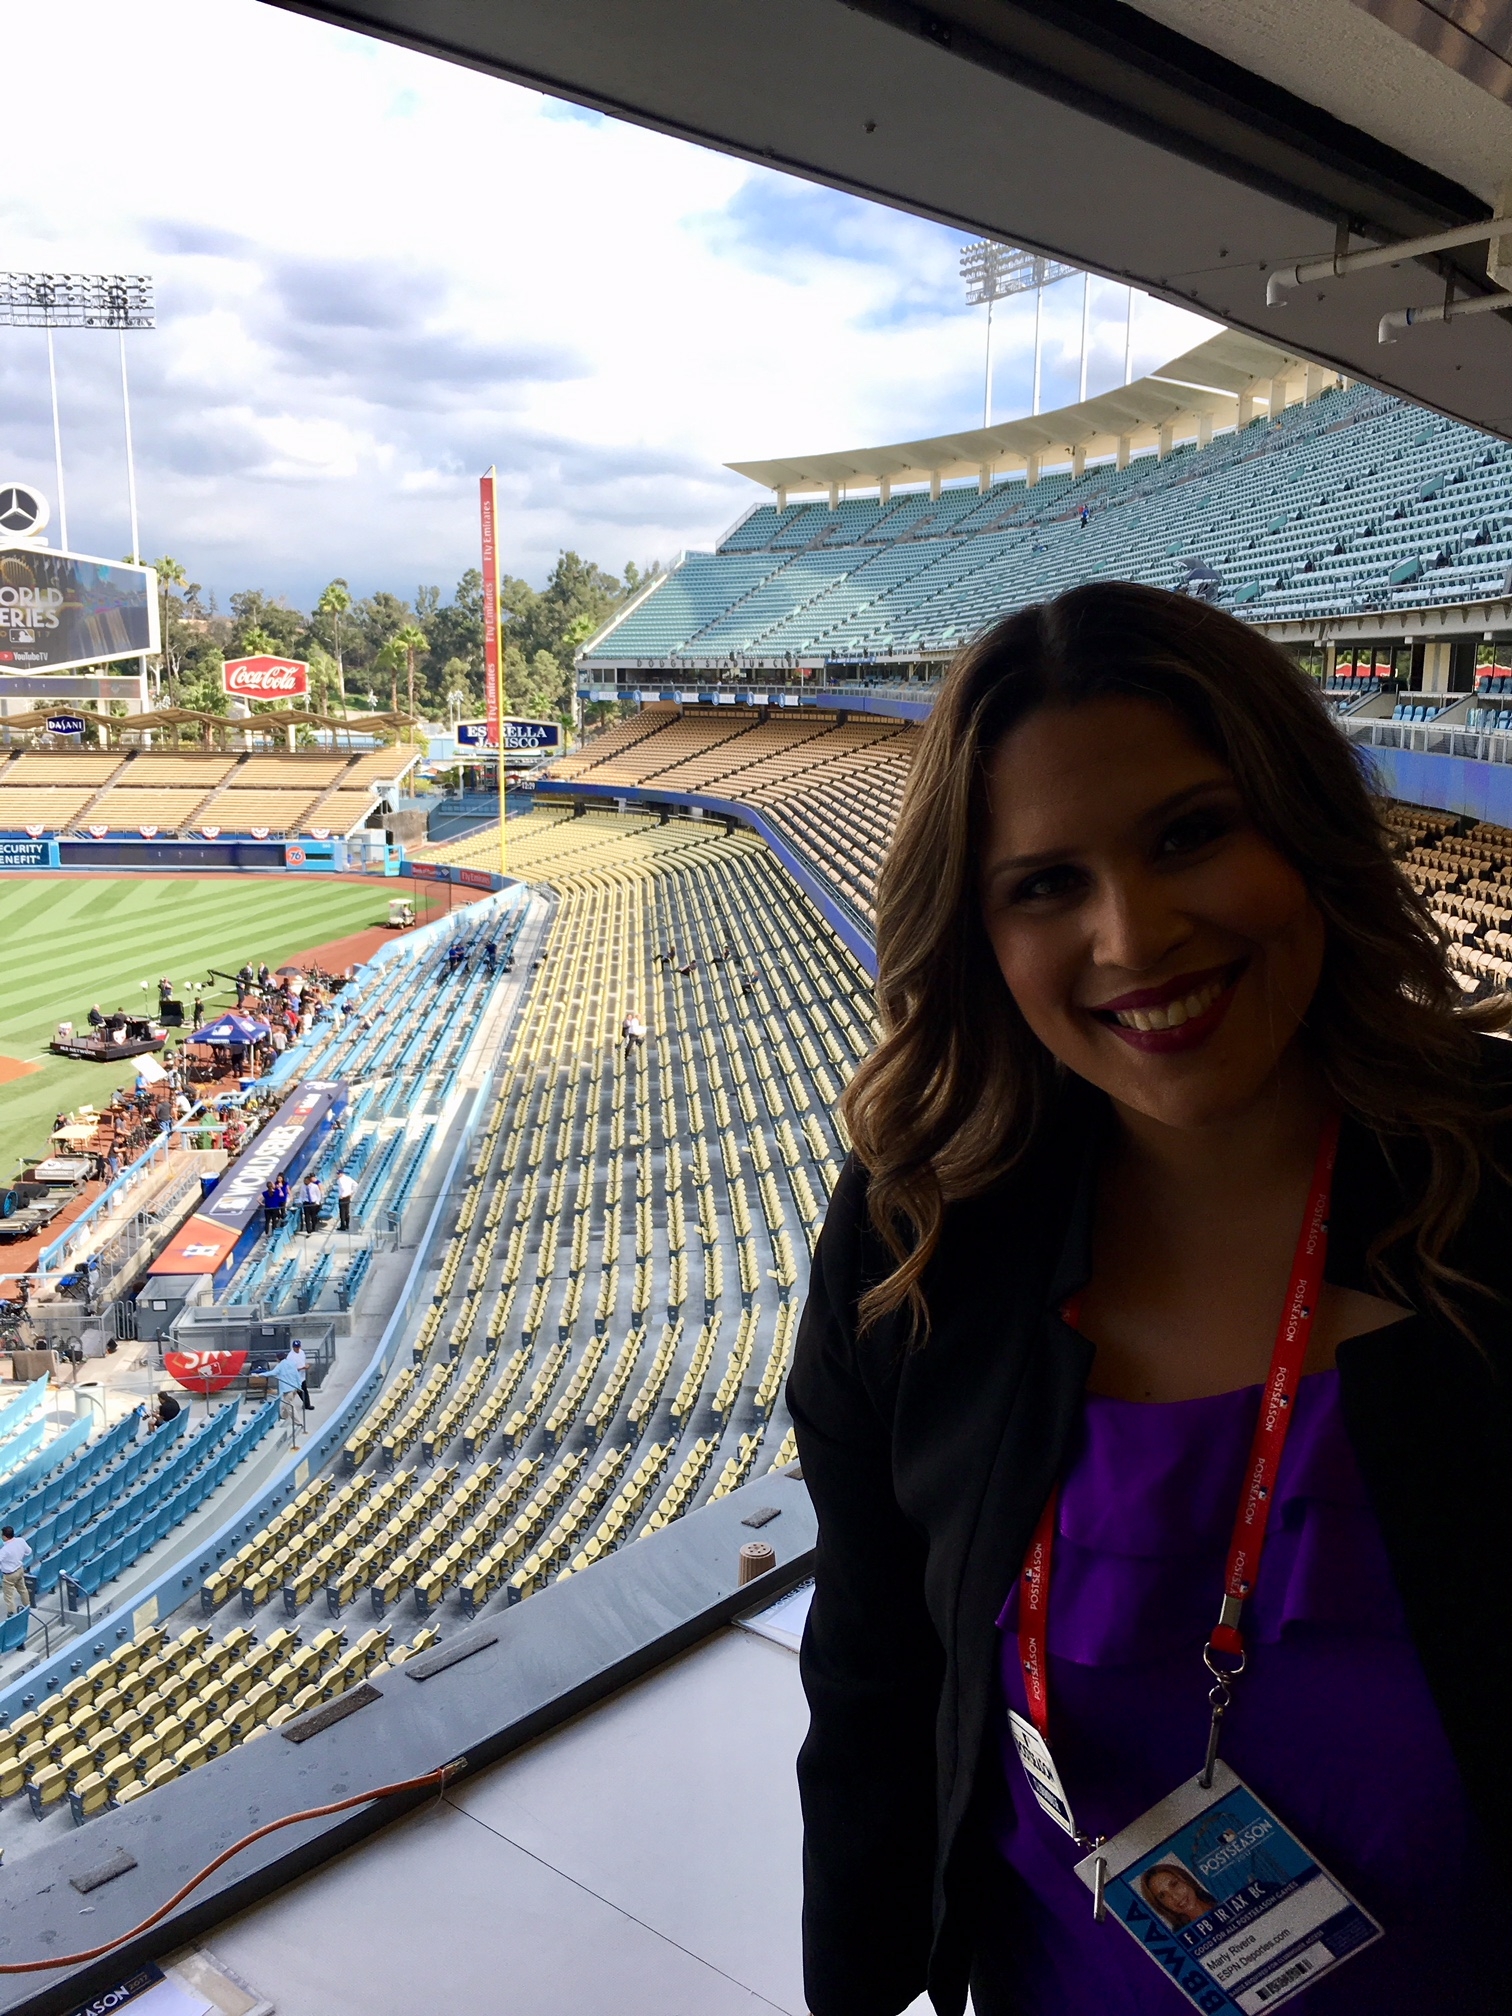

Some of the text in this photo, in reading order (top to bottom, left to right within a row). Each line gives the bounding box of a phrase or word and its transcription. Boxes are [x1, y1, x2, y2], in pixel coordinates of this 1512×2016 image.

[483, 500, 493, 560] Fly Emirates
[486, 582, 496, 642] Fly Emirates
[230, 666, 299, 690] Coca-Cola
[487, 663, 498, 722] Fly Emirates
[636, 660, 694, 668] DODGER
[706, 660, 764, 668] STADIUM
[48, 719, 82, 731] DASANI
[290, 852, 301, 860] 76
[462, 871, 490, 884] Fly Emirates
[222, 1126, 304, 1197] WORLD SERIES
[1306, 1194, 1326, 1255] POSTSEASON
[1286, 1279, 1308, 1342] POSTSEASON
[1266, 1366, 1286, 1432] POSTSEASON
[1244, 1458, 1266, 1525] POSTSEASON
[1030, 1543, 1042, 1610] POSTSEASON
[1028, 1638, 1040, 1700] POSTSEASON
[1200, 1818, 1272, 1876] POSTSEASON
[1183, 1882, 1266, 1945] F PB IR AX BC
[1194, 1880, 1300, 1956] GOOD FOR ALL POSTSEASON GAMES
[1126, 1900, 1227, 2015] BBWAA
[1206, 1934, 1256, 1971] Marly Rivera
[1216, 1962, 1242, 1982] ESPN
[1238, 1928, 1290, 1966] Deportes.com
[75, 1974, 148, 2016] ASON 2017
